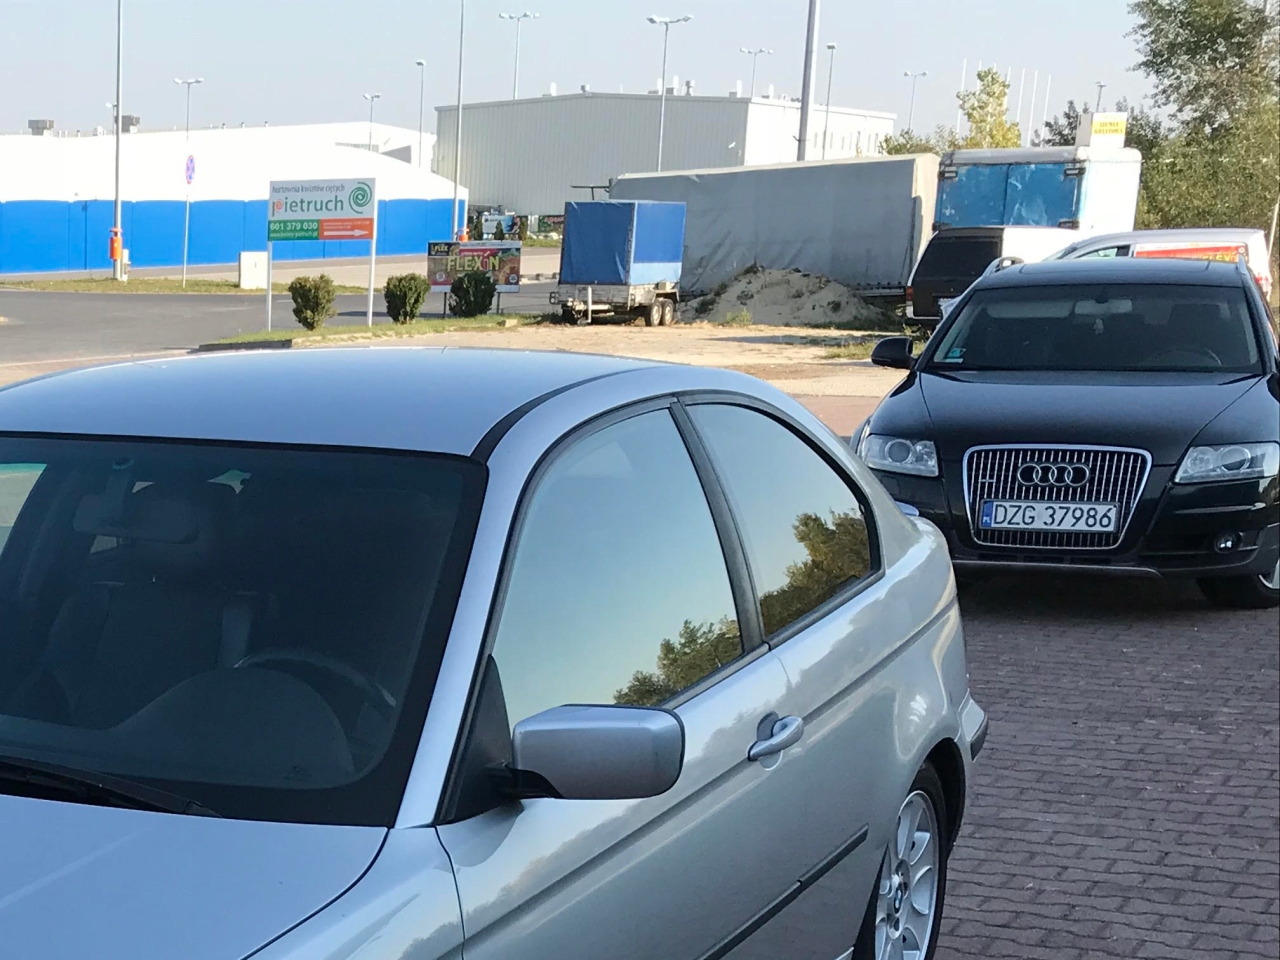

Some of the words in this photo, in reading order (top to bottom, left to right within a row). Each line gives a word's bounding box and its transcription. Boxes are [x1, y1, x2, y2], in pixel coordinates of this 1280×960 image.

[271, 194, 344, 217] pietruch
[270, 222, 284, 231] 601
[286, 222, 301, 231] 379
[303, 221, 318, 230] 030
[993, 503, 1037, 526] DZG
[1042, 505, 1113, 529] 37986
